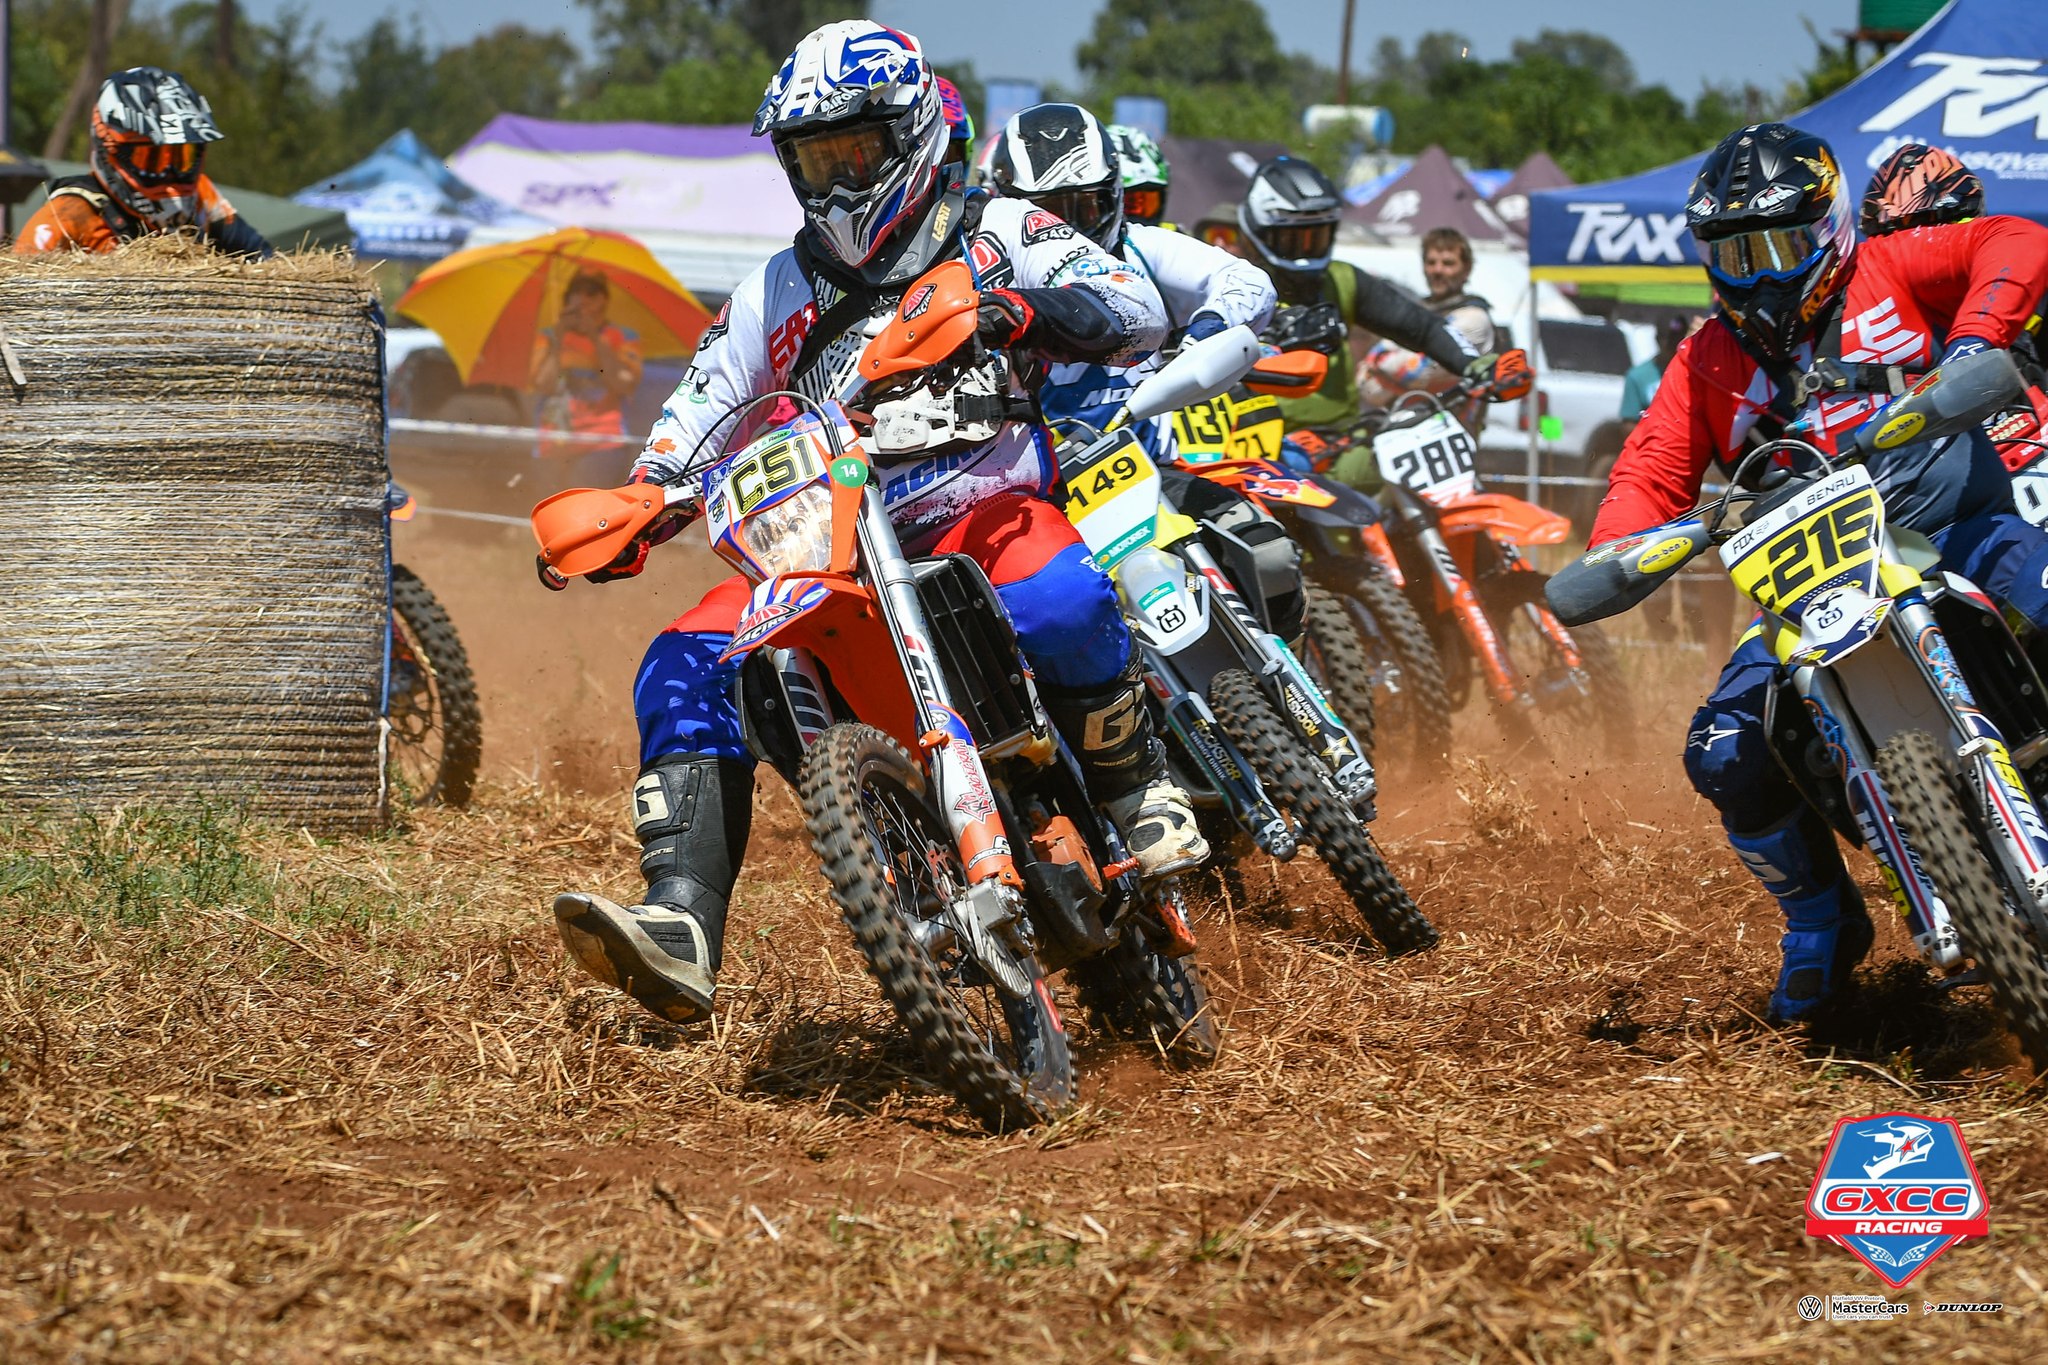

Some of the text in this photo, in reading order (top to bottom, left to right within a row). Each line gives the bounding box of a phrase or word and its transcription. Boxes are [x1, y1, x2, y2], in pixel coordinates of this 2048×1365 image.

[1566, 203, 1688, 263] TRAX
[841, 464, 858, 478] 14
[1069, 456, 1137, 508] 149
[1392, 433, 1475, 491] 288
[1108, 526, 1151, 556] MOTOREX
[1733, 530, 1755, 554] FOX
[1191, 718, 1243, 781] ROCKSTAR
